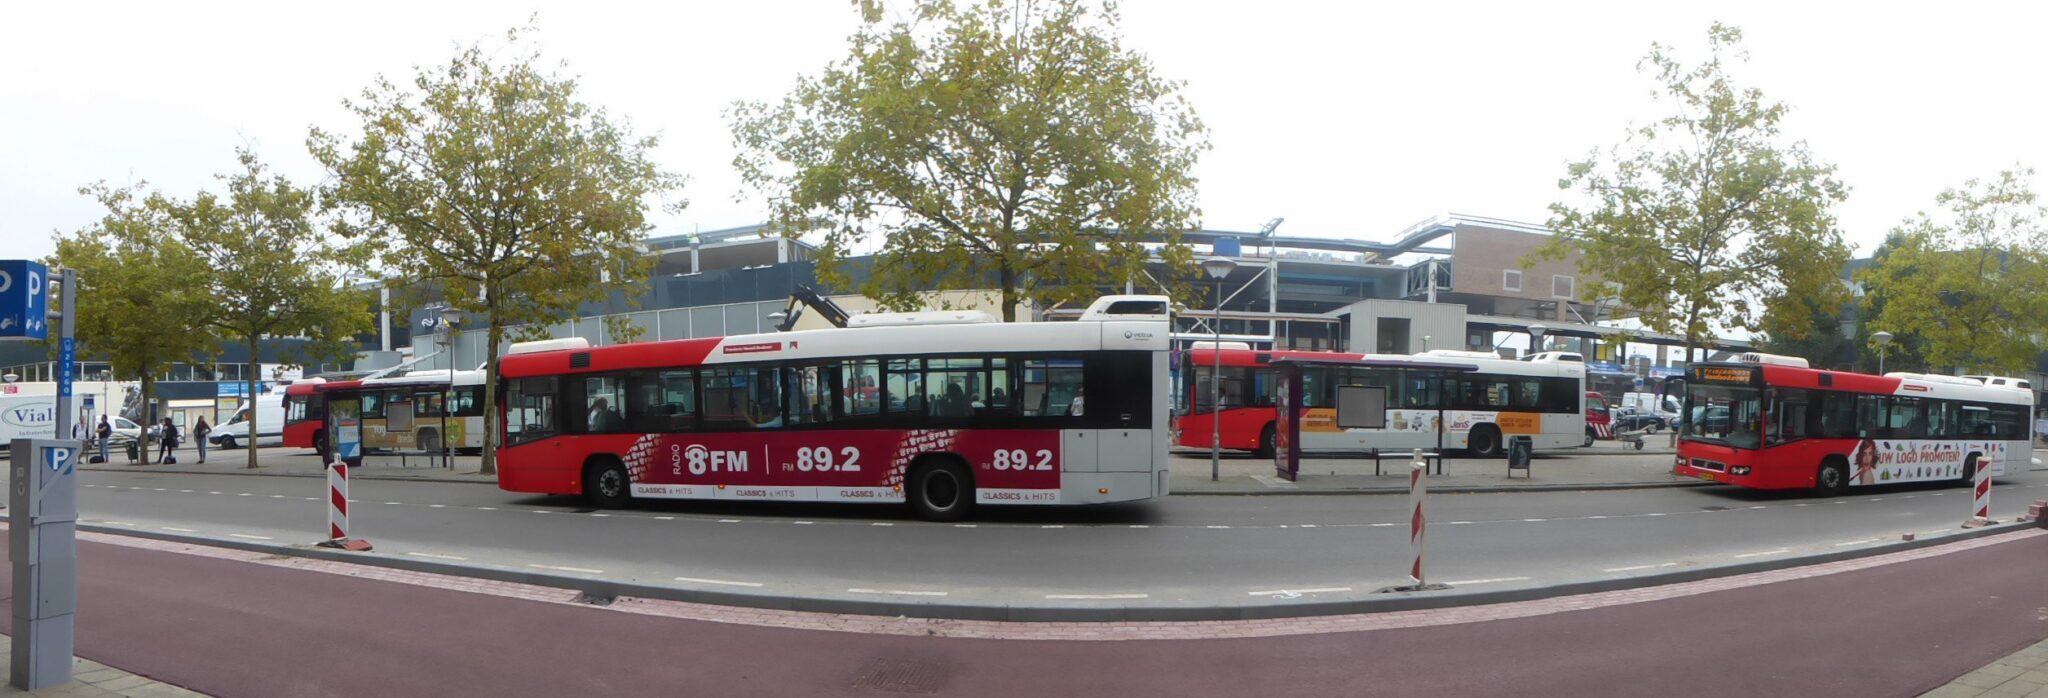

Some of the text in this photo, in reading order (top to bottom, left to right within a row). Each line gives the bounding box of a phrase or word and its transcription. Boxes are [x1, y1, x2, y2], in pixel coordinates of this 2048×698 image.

[28, 271, 41, 308] P
[14, 408, 56, 422] Vial
[53, 448, 69, 470] P
[671, 444, 681, 475] RADIO
[782, 446, 861, 472] FM 89.2
[993, 449, 1053, 471] 89.2
[1878, 452, 1893, 464] UW
[1896, 451, 1917, 463] LOGO
[638, 487, 667, 495] CLASSICS
[774, 490, 795, 498] HITS
[840, 490, 874, 498] CLASSICS
[982, 492, 1021, 500] CLASSICS
[1032, 492, 1056, 501] HITS
